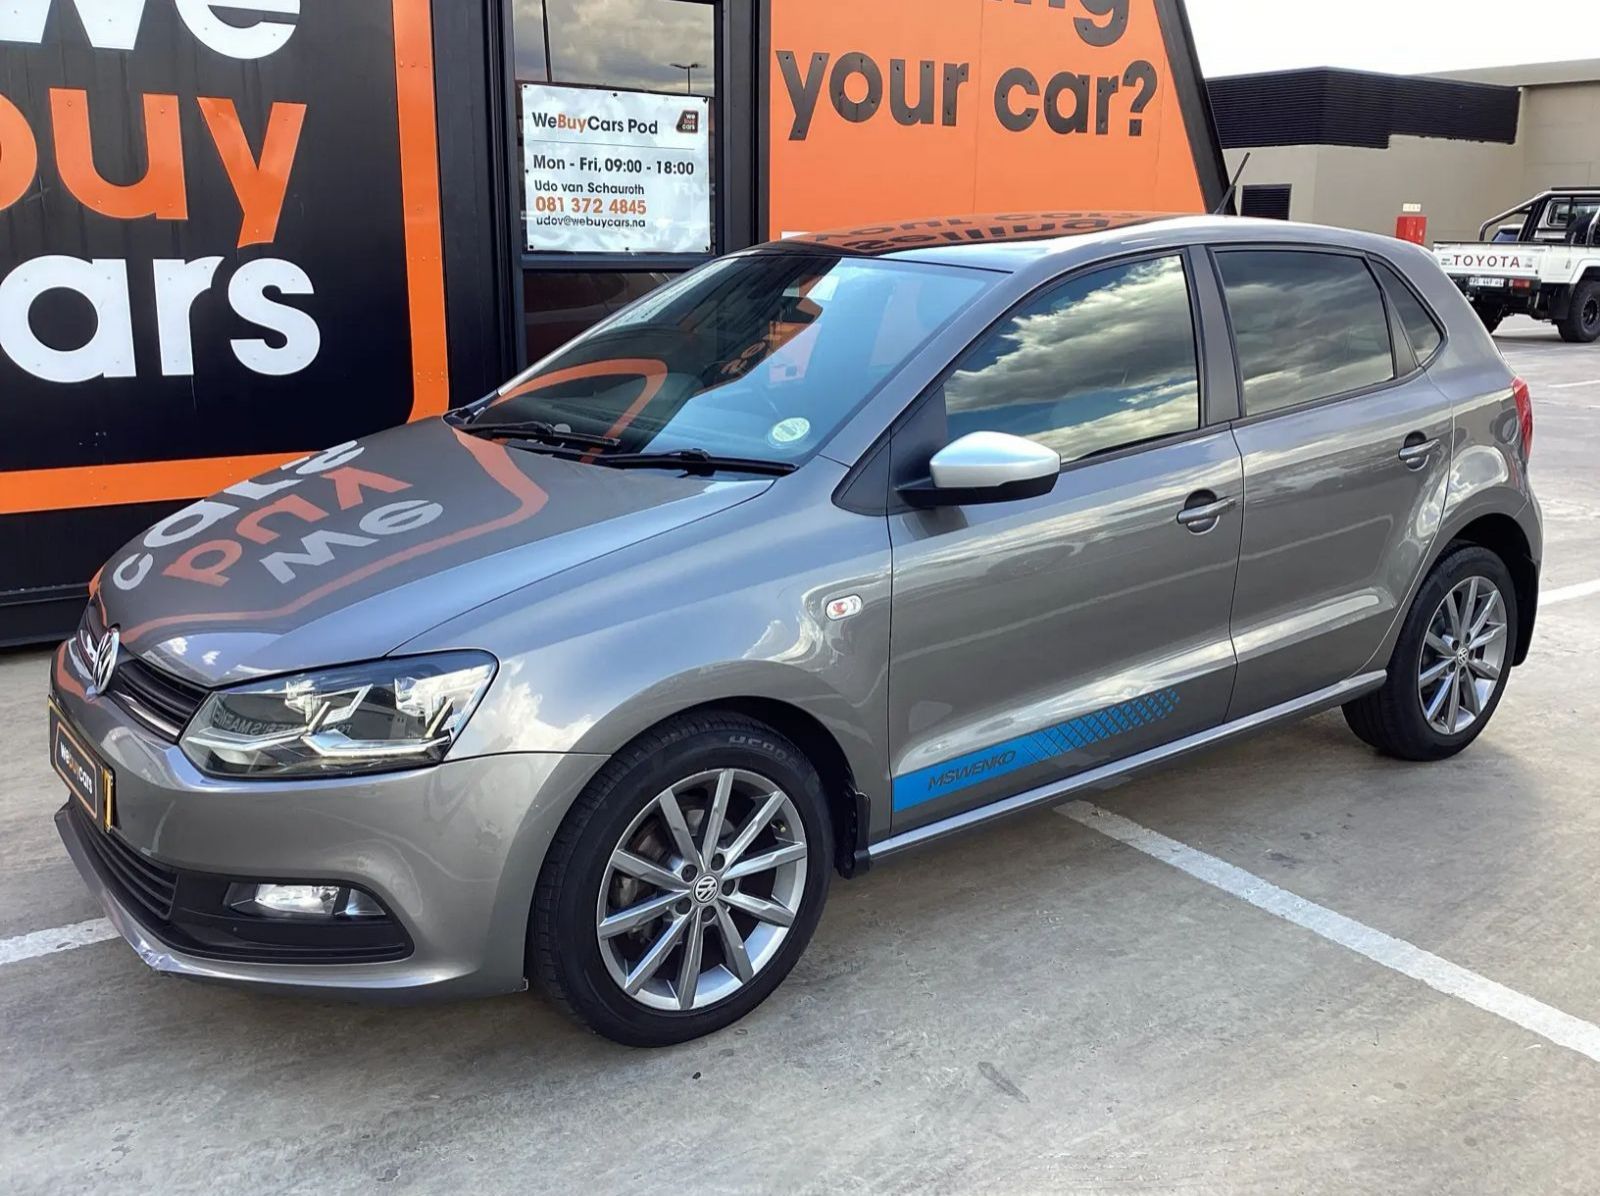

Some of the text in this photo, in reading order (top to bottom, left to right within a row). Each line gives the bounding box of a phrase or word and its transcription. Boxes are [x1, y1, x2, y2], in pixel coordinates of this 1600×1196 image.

[776, 50, 1158, 141] your car?
[532, 112, 659, 134] WeBuyCars Pod
[0, 87, 307, 248] uy
[533, 155, 566, 170] Mon
[579, 157, 602, 173] Fri,
[604, 158, 642, 173] 09:00
[656, 160, 695, 175] 18:00
[534, 179, 645, 195] Udo van Schauroth
[535, 196, 647, 214] 081 372 4845
[536, 215, 646, 228] udov@webuycars.na
[1453, 254, 1520, 268] TOYOTA
[927, 751, 1016, 791] MSWENKO
